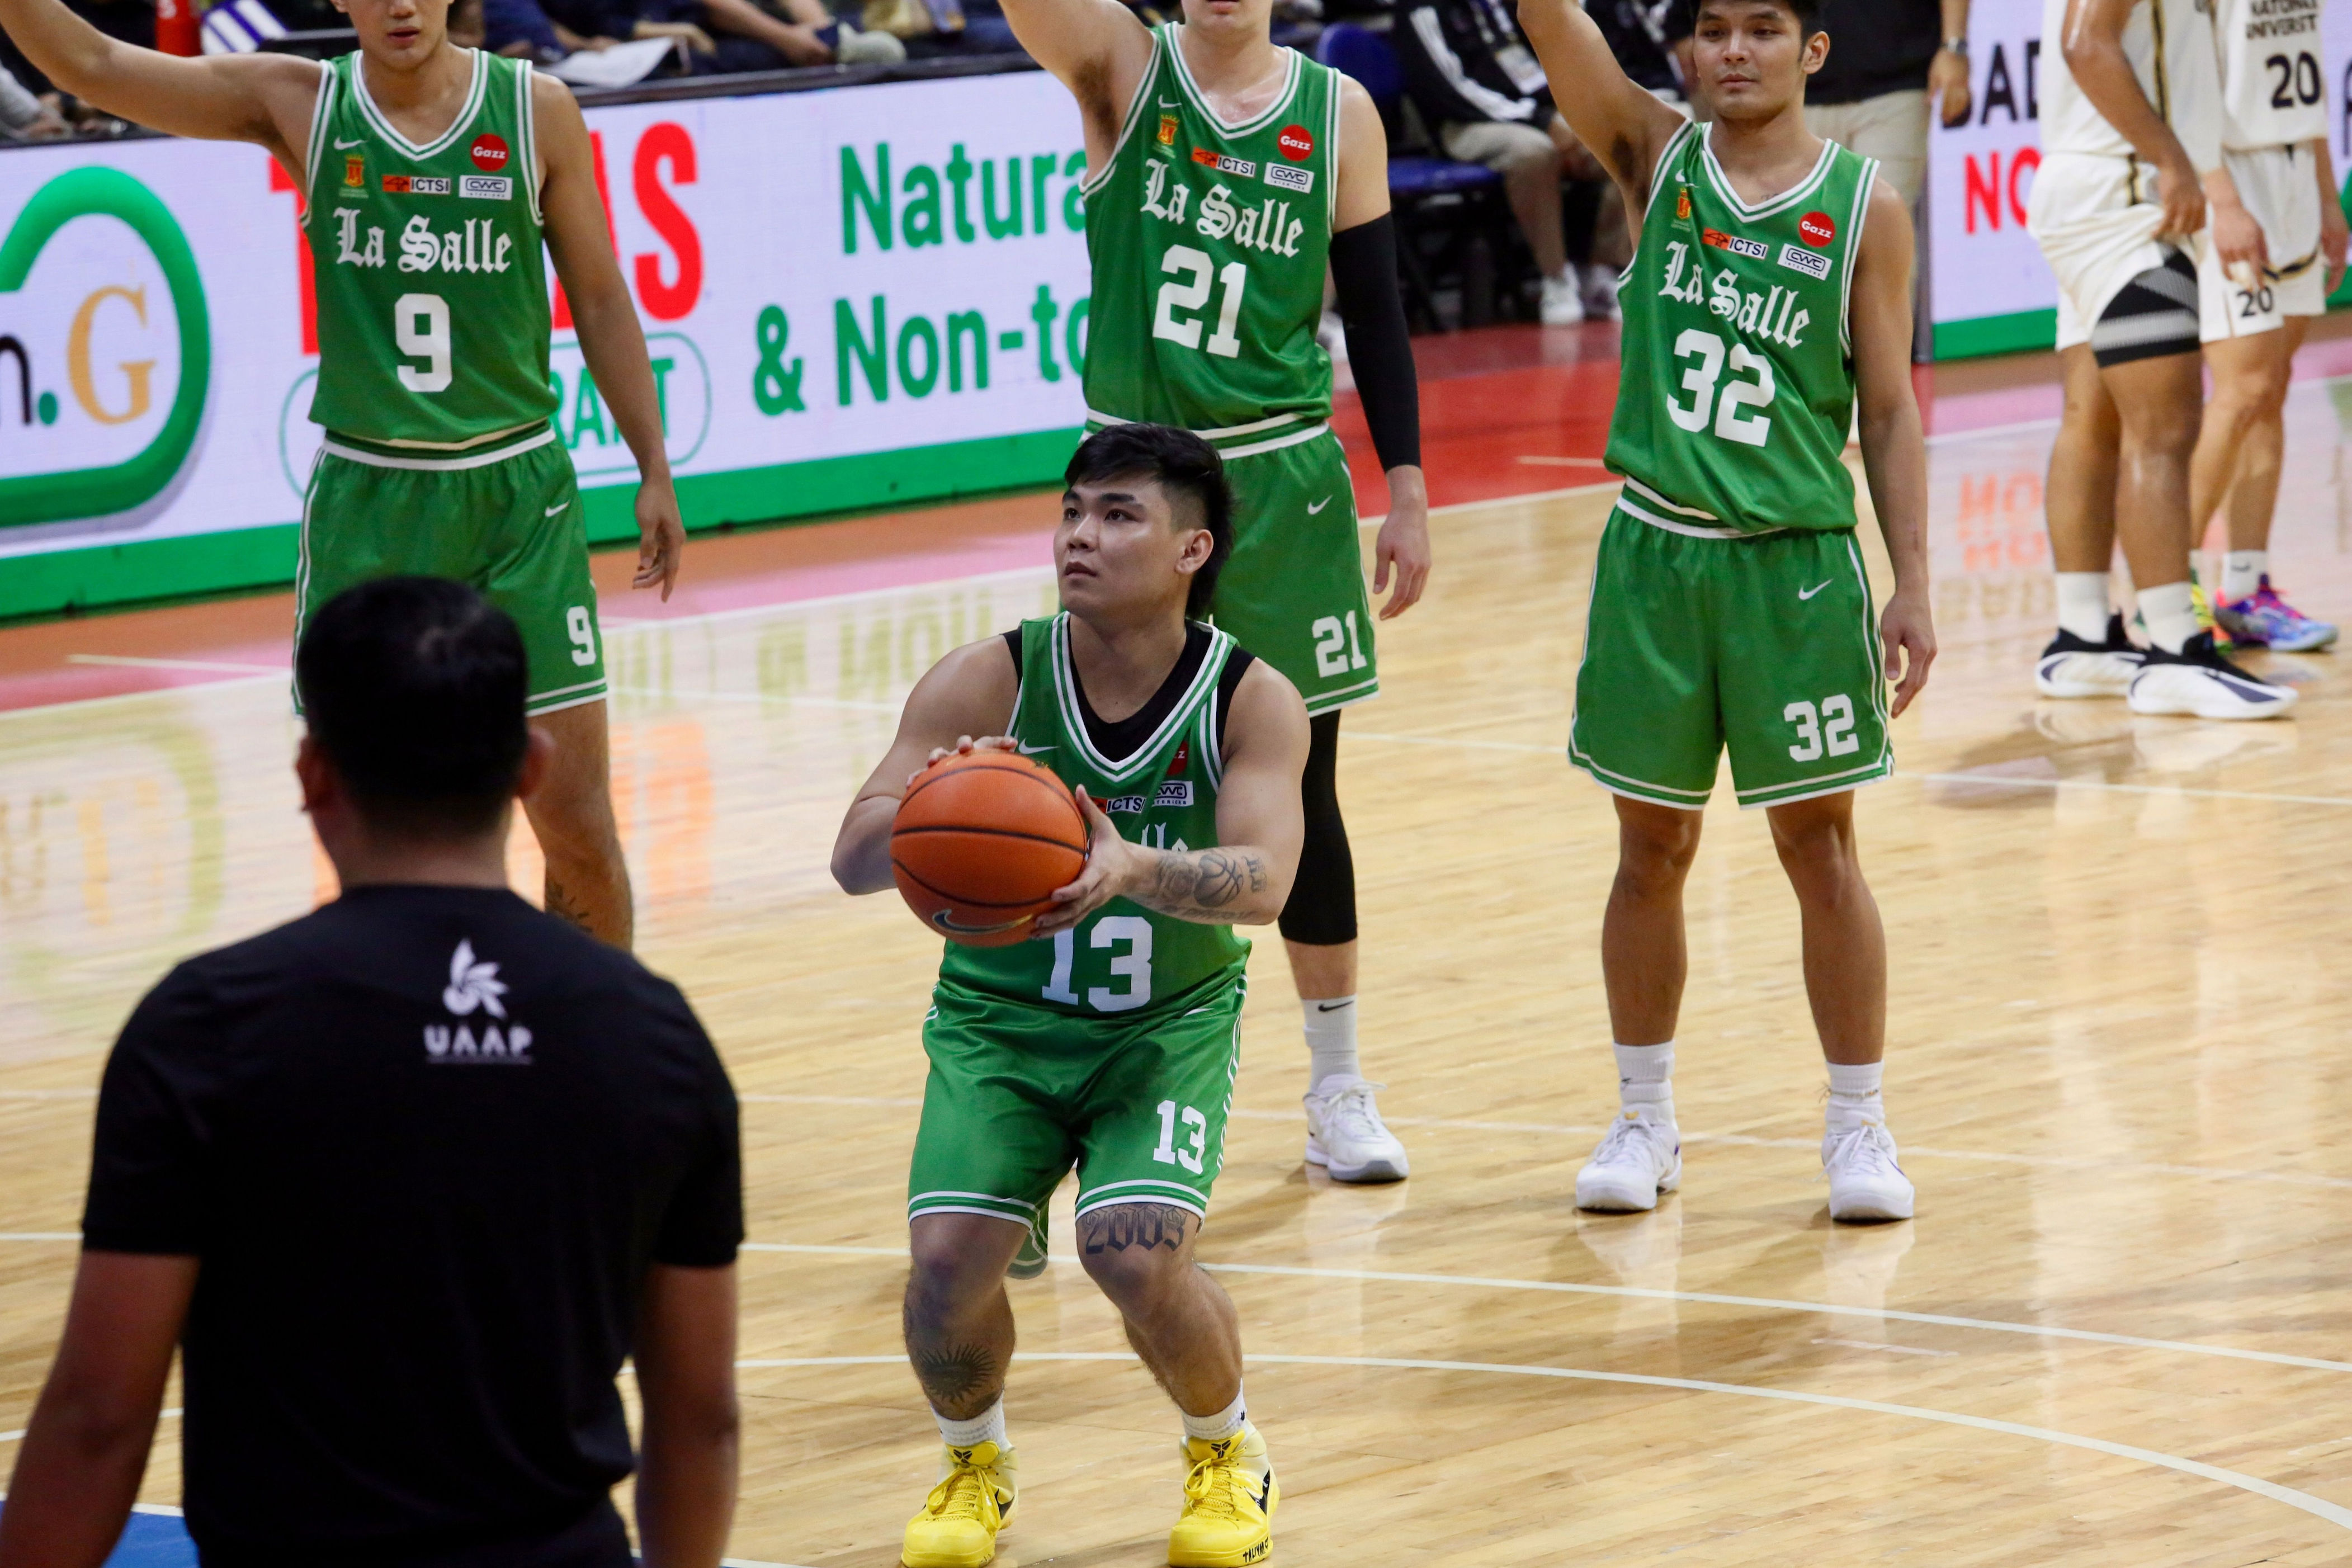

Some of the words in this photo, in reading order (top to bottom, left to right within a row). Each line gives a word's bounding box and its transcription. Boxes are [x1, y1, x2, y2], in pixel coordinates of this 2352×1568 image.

[2266, 51, 2321, 108] 20
[473, 146, 506, 159] Gazz
[1218, 157, 1254, 174] ICTSI
[1280, 135, 1311, 151] Gazz
[411, 179, 449, 191] ICTSI
[470, 181, 503, 190] CWC
[1276, 169, 1305, 182] CWC
[1140, 158, 1189, 224] La
[1196, 183, 1304, 258] Salle
[1801, 220, 1833, 239] Gazz
[334, 206, 386, 268] La
[398, 214, 512, 273] Salle
[1730, 238, 1766, 257] ICTSI
[1791, 252, 1822, 268] CWC
[1152, 241, 1247, 358] 21
[1658, 240, 1704, 305] La
[1709, 268, 1810, 349] Salle
[2236, 287, 2273, 318] 20
[394, 293, 452, 393] 9
[753, 304, 806, 417] &
[1665, 328, 1776, 447] 32
[566, 605, 597, 667] 9
[1312, 610, 1368, 678] 21
[1783, 693, 1859, 762] 32
[1157, 786, 1183, 795] WC
[1042, 915, 1153, 1012] 13
[423, 1023, 532, 1056] UAAP
[1153, 1099, 1207, 1175] 13
